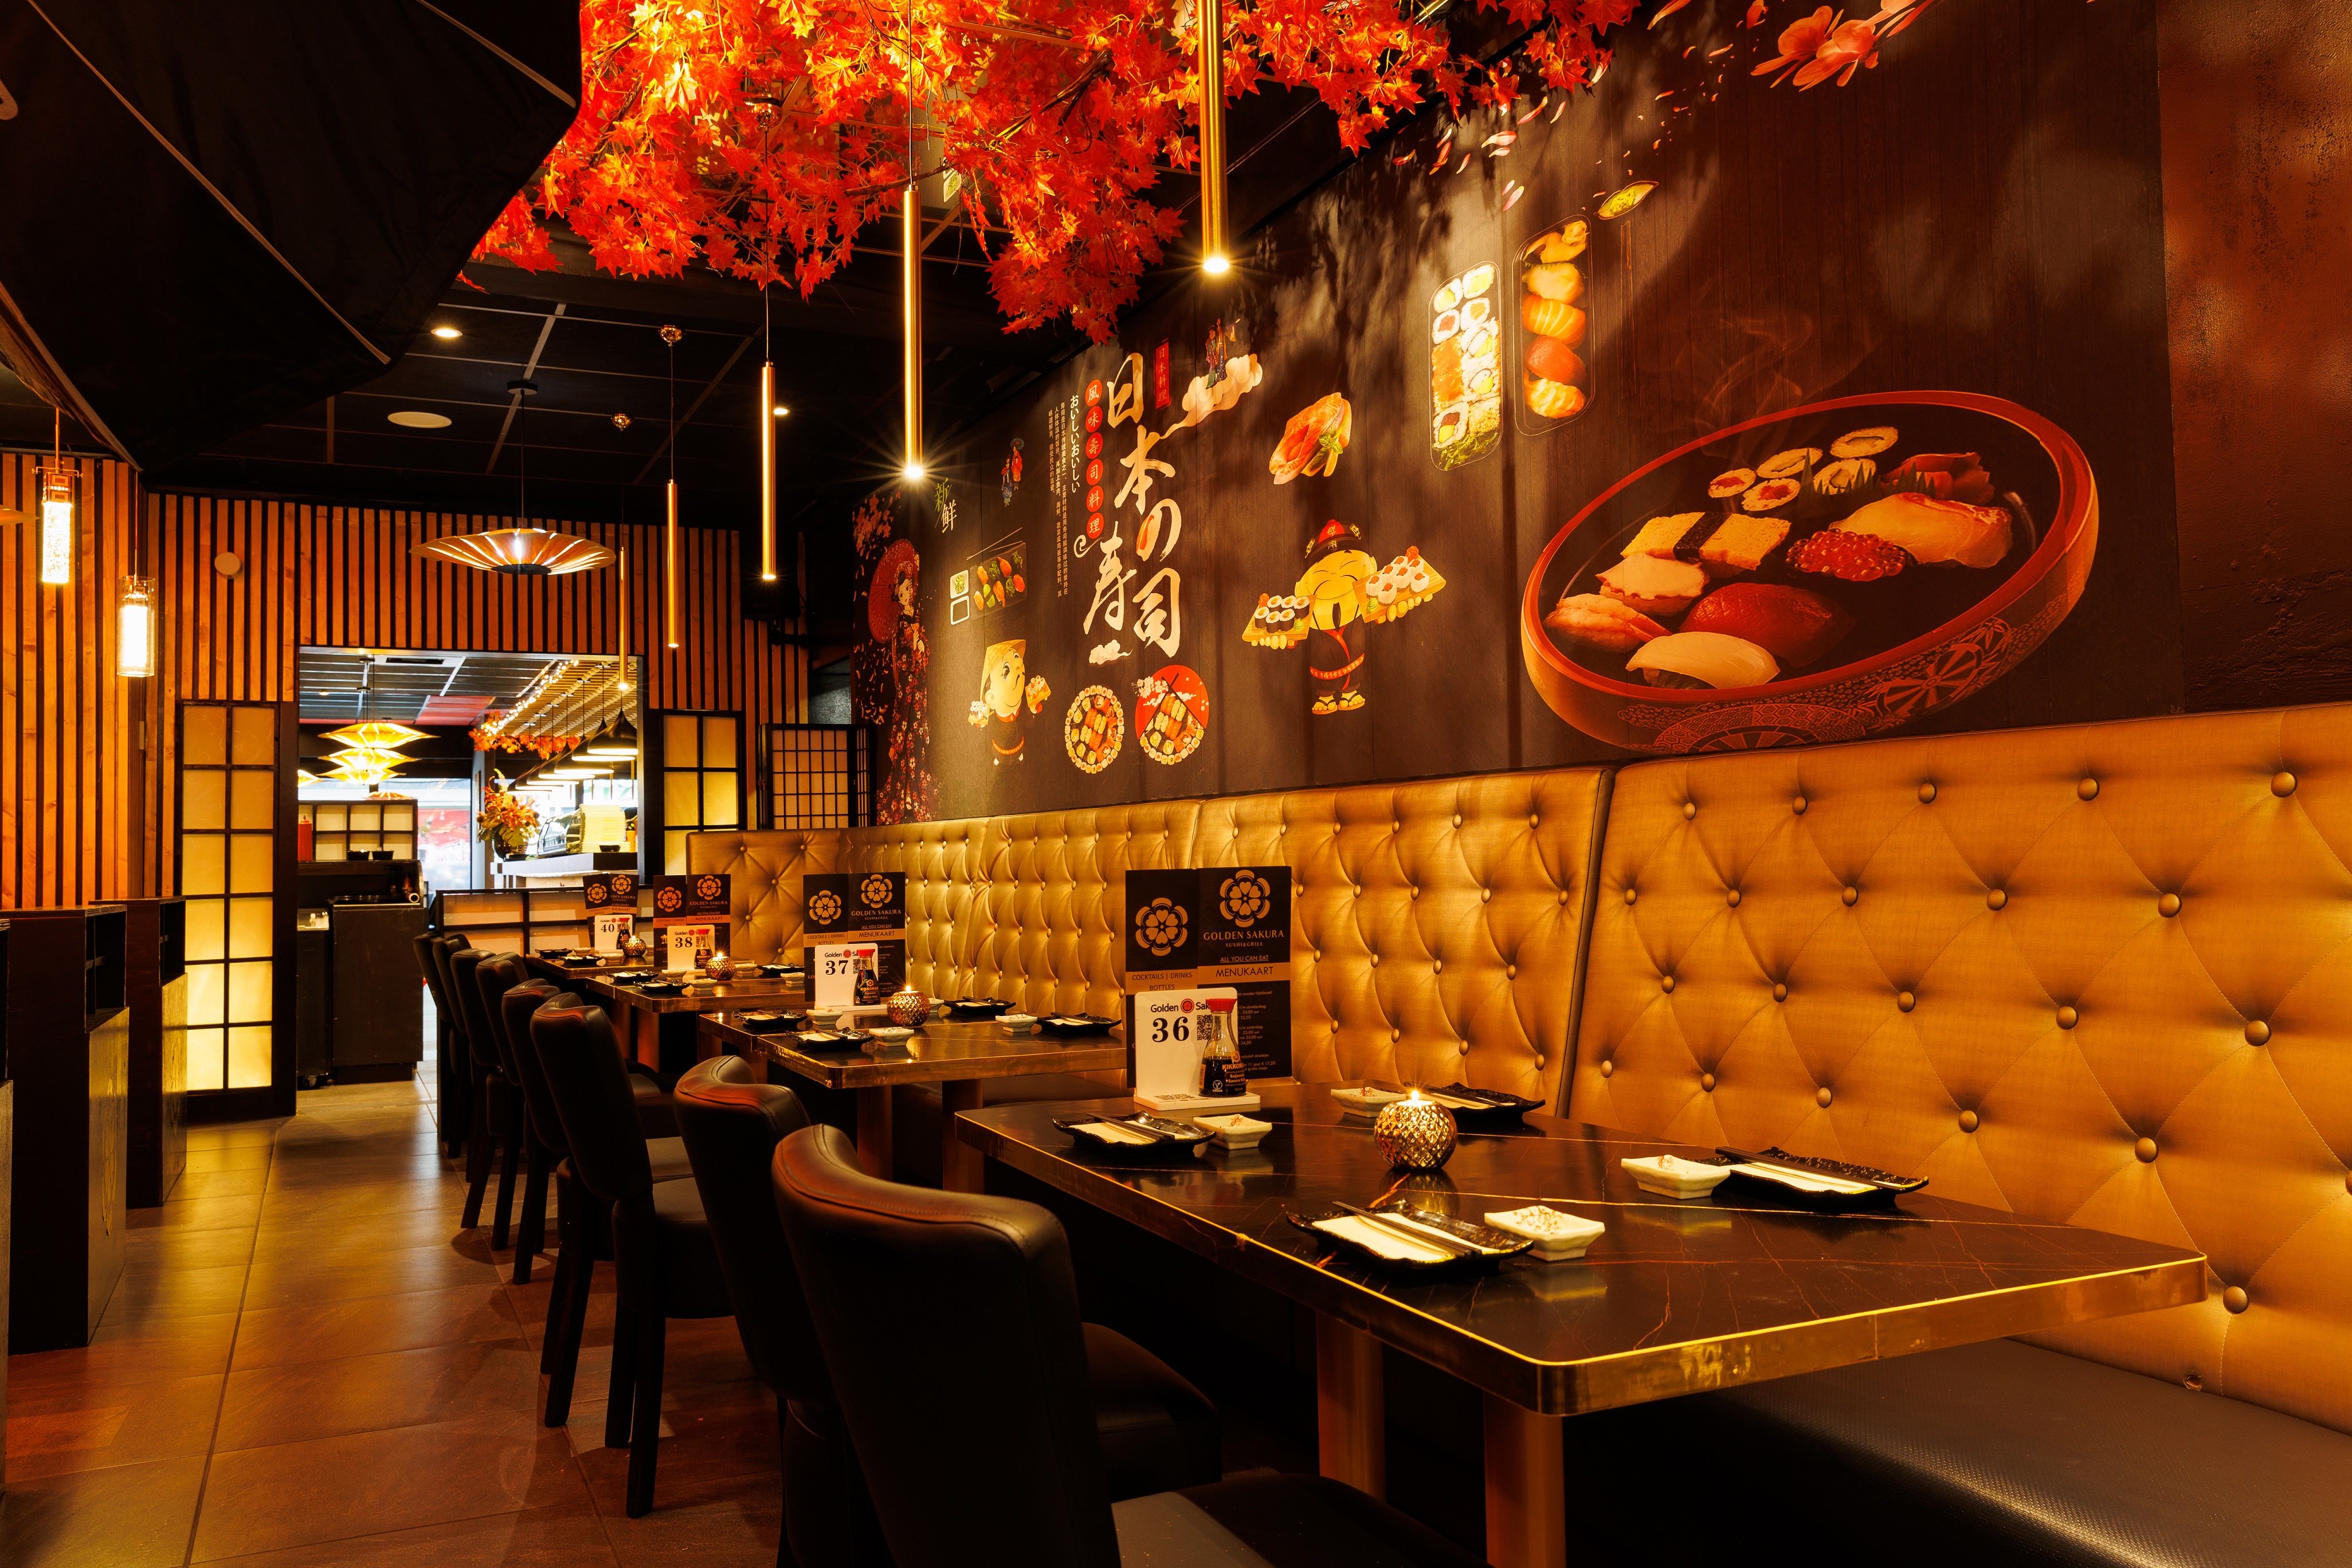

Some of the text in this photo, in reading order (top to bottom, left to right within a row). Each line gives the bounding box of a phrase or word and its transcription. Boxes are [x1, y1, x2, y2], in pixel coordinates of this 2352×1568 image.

[1158, 348, 1167, 402] 日本料理
[1070, 395, 1080, 493] おいしいおいしい
[1088, 385, 1100, 534] 風味壽司料理
[1084, 352, 1182, 658] 日本の寿司
[601, 924, 614, 932] 40
[1204, 930, 1284, 940] GOLDEN SAKURA
[675, 937, 692, 948] 38
[825, 960, 849, 975] 37
[1216, 966, 1274, 977] MENUKAART
[1151, 1002, 1210, 1013] Golden Sak
[1152, 1016, 1189, 1042] 36
